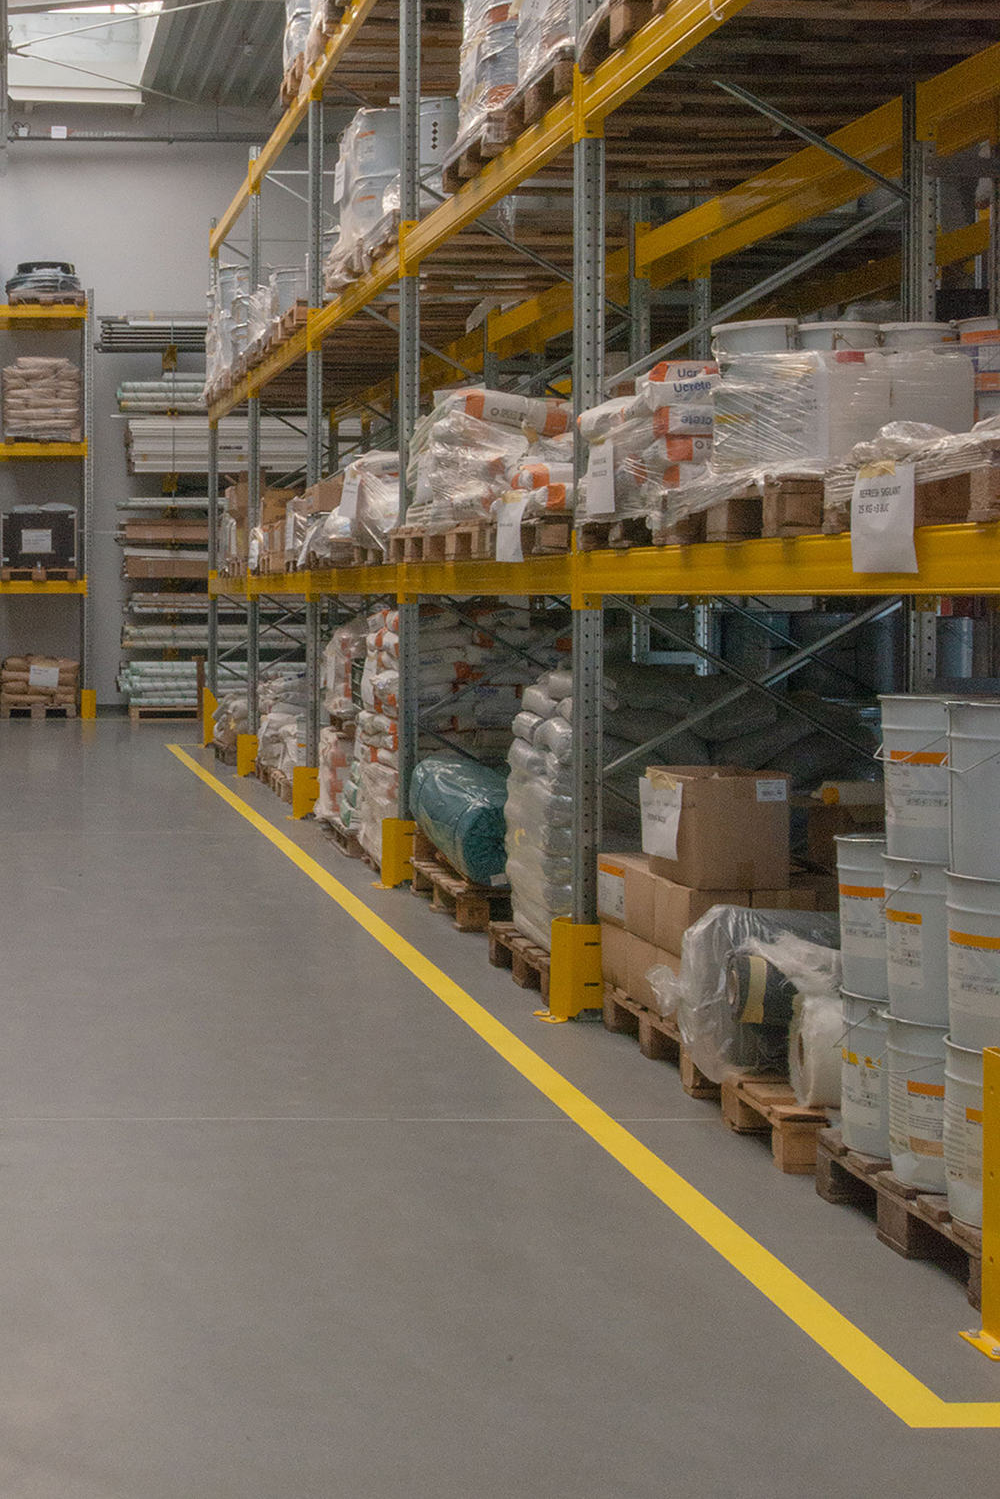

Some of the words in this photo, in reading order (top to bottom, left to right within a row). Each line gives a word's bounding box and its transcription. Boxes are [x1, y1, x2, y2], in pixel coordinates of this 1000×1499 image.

[677, 368, 699, 378] Ucr
[673, 381, 712, 393] Ucrete
[681, 416, 712, 425] crete
